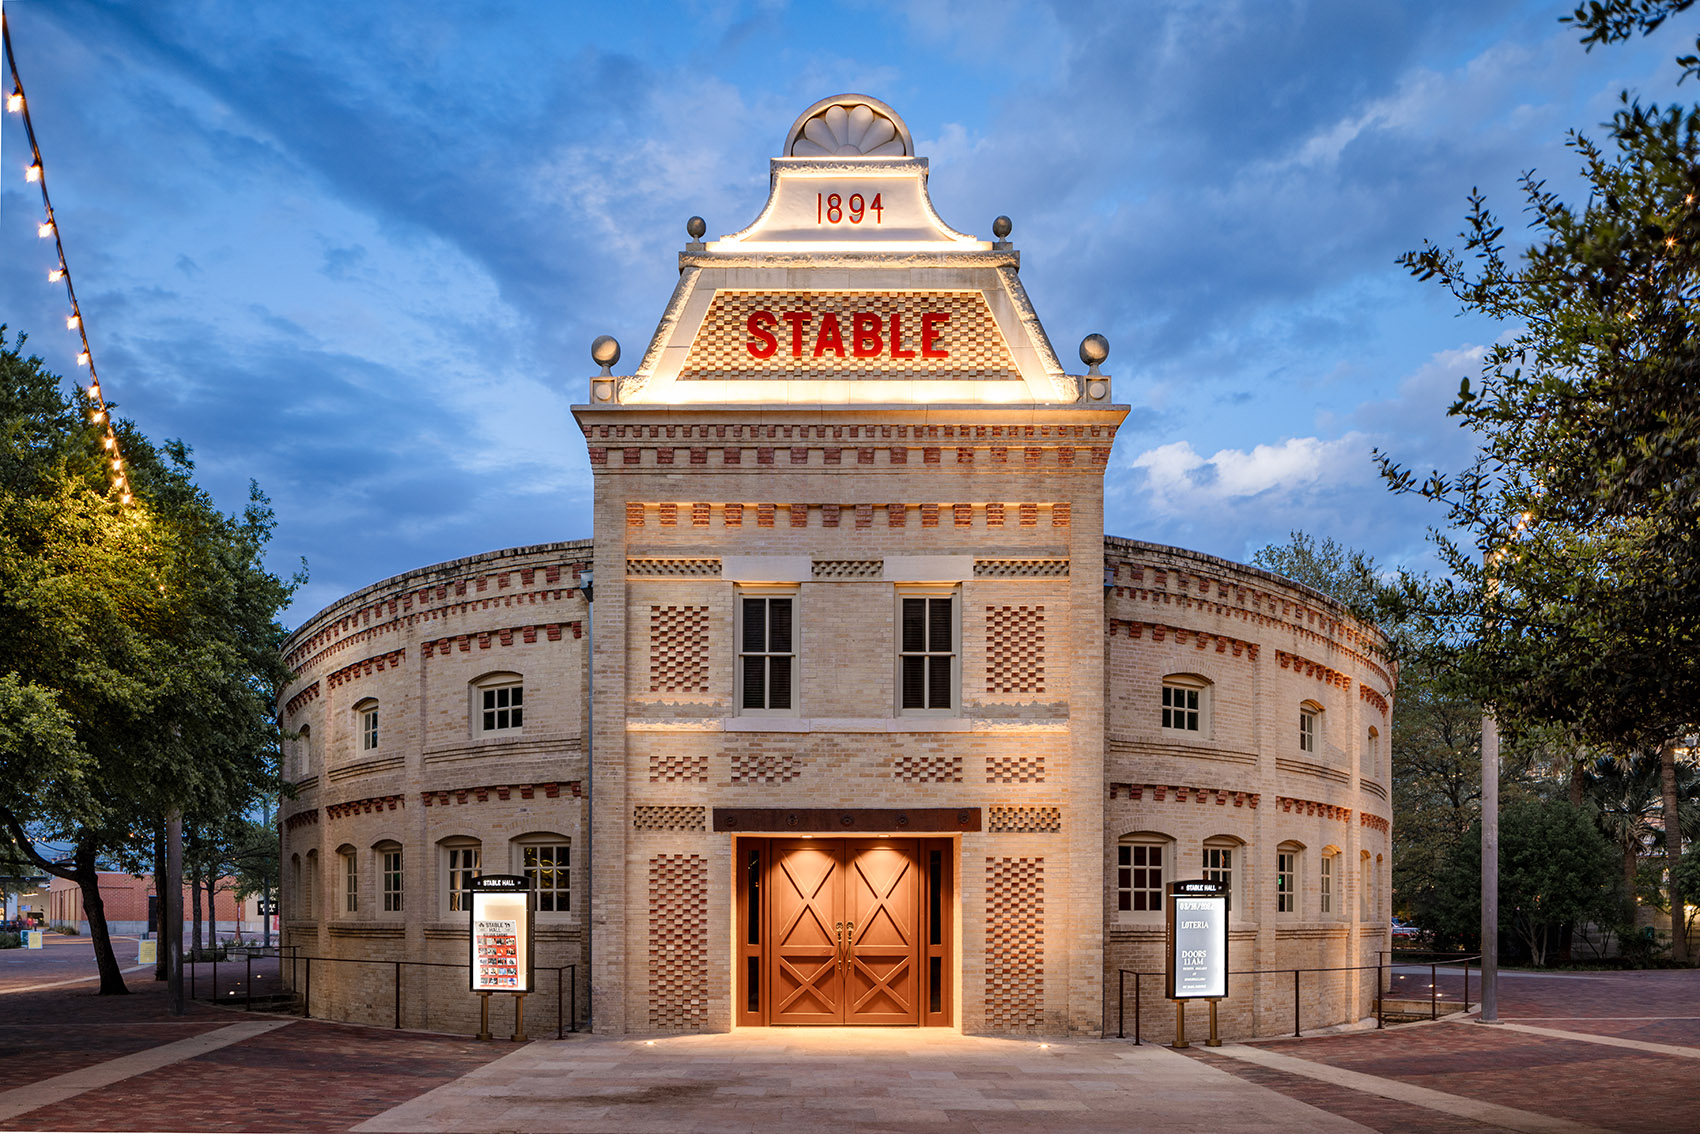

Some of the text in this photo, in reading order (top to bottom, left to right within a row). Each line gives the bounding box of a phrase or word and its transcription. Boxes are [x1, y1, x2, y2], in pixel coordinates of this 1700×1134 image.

[817, 192, 884, 224] 1894
[746, 311, 950, 359] STABLE
[483, 879, 515, 887] STABLE HALL
[1181, 921, 1209, 929] LOTERIA
[1181, 950, 1207, 958] DOORS
